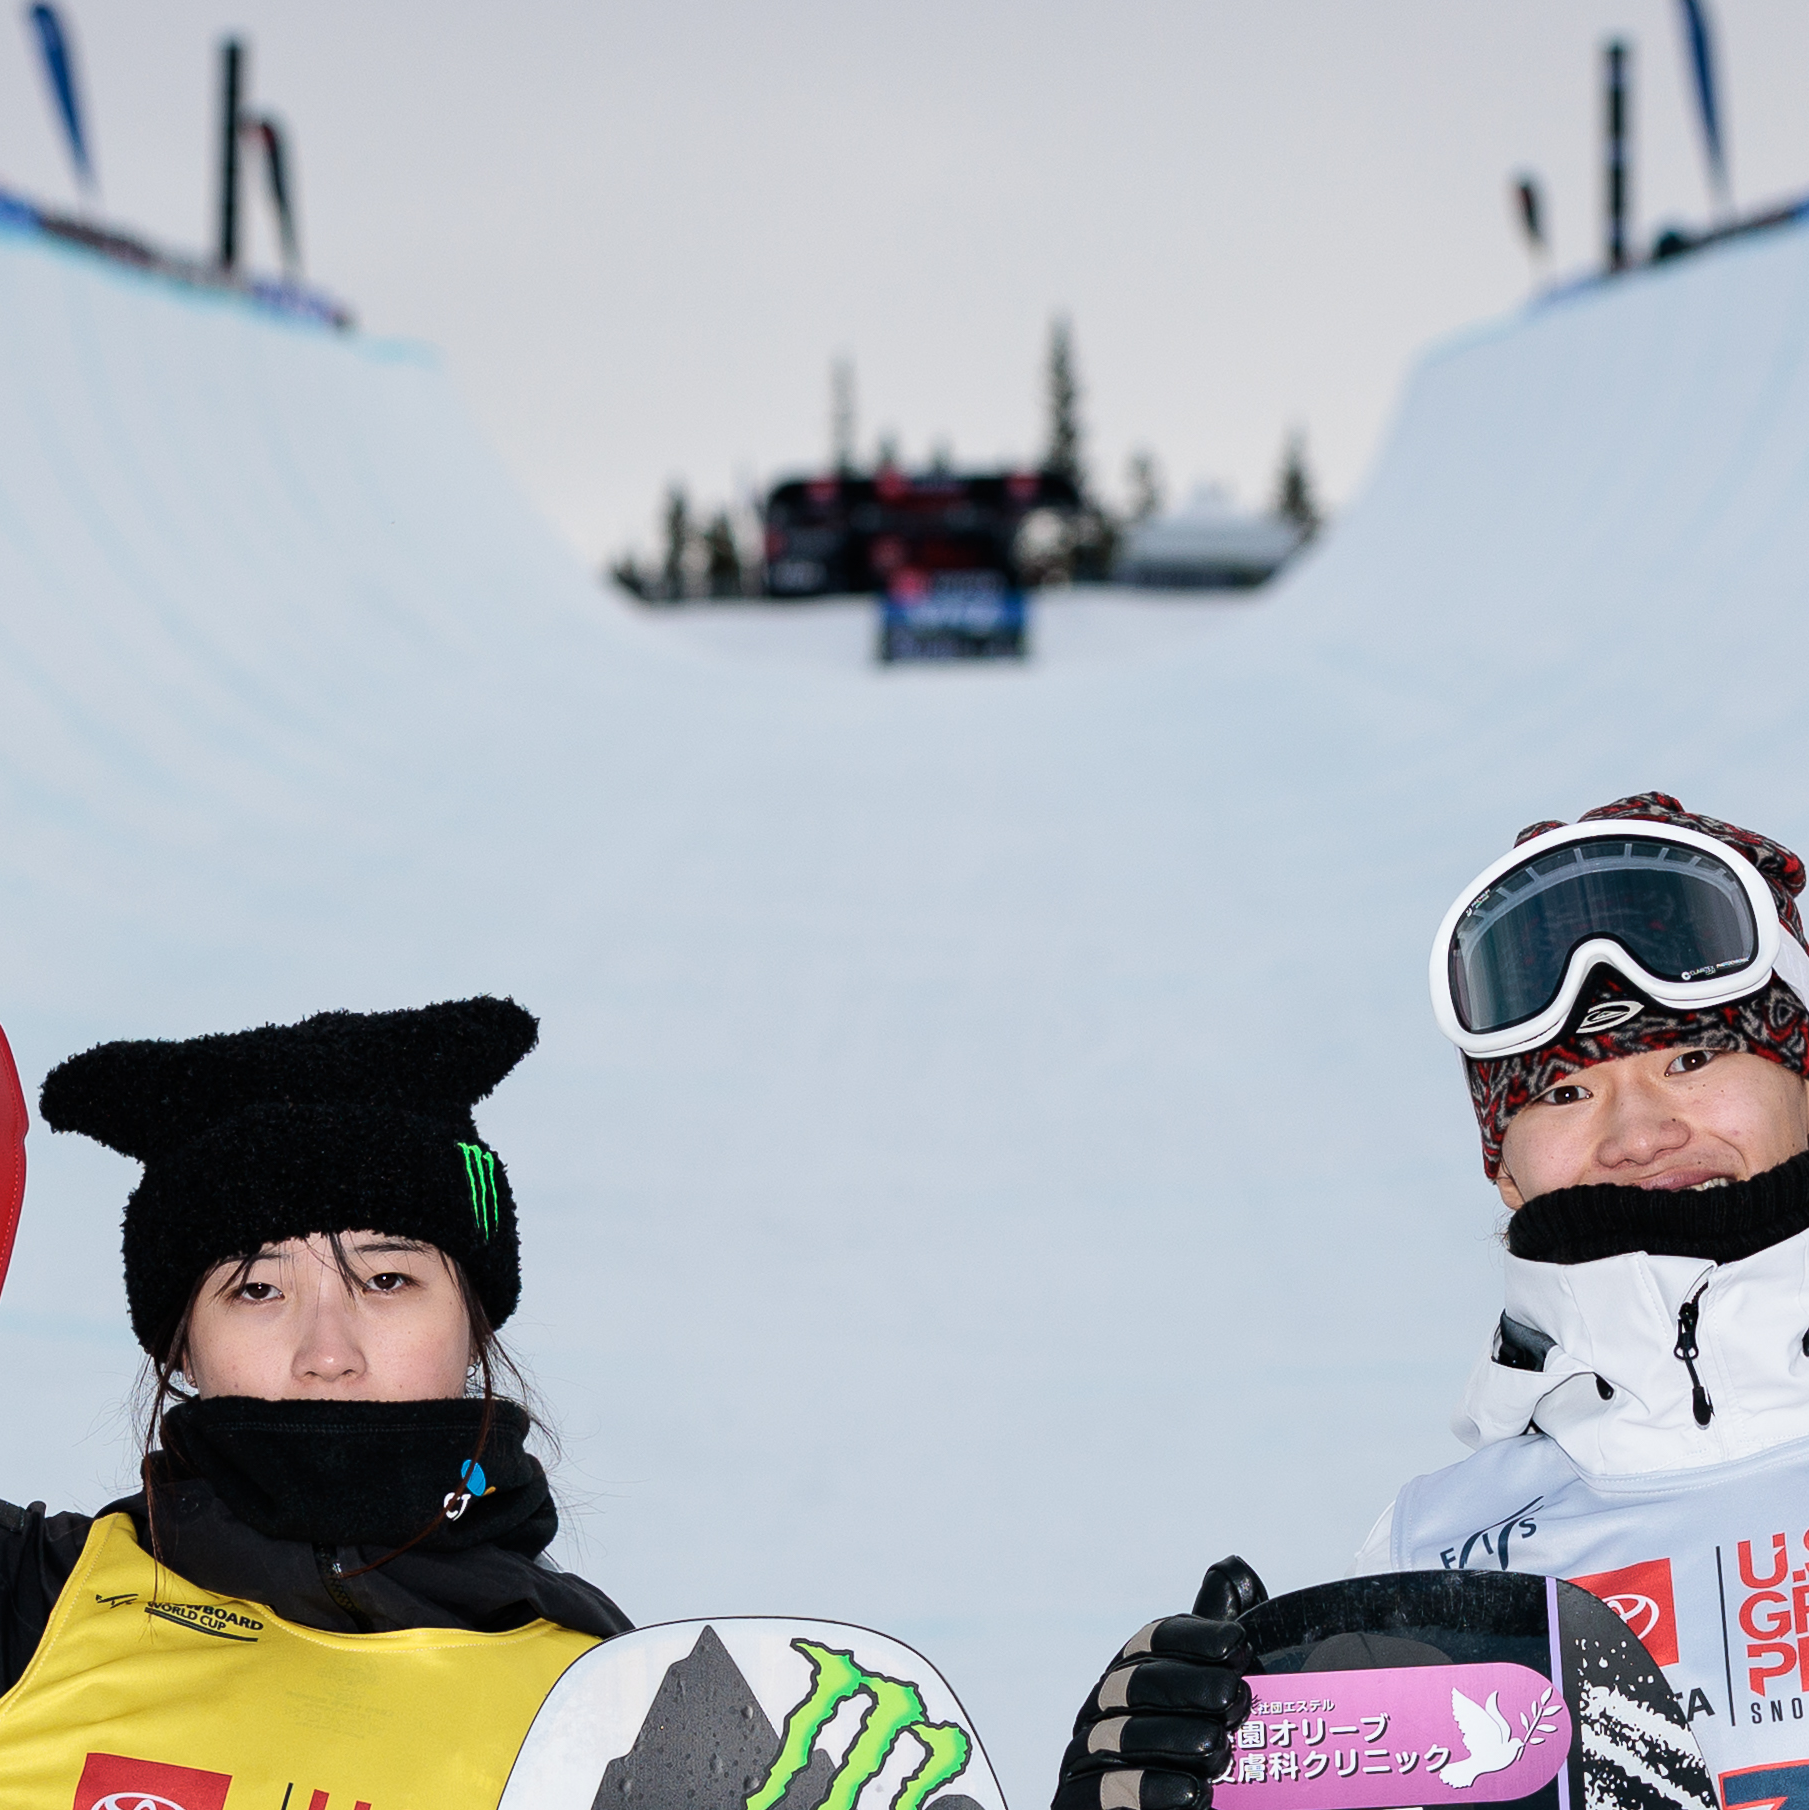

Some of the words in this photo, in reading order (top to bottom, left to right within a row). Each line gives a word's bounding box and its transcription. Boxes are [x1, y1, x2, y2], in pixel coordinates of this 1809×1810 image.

[147, 1602, 198, 1622] WORLD
[199, 1614, 226, 1631] CUP
[1228, 1712, 1391, 1749] 園オリーブ
